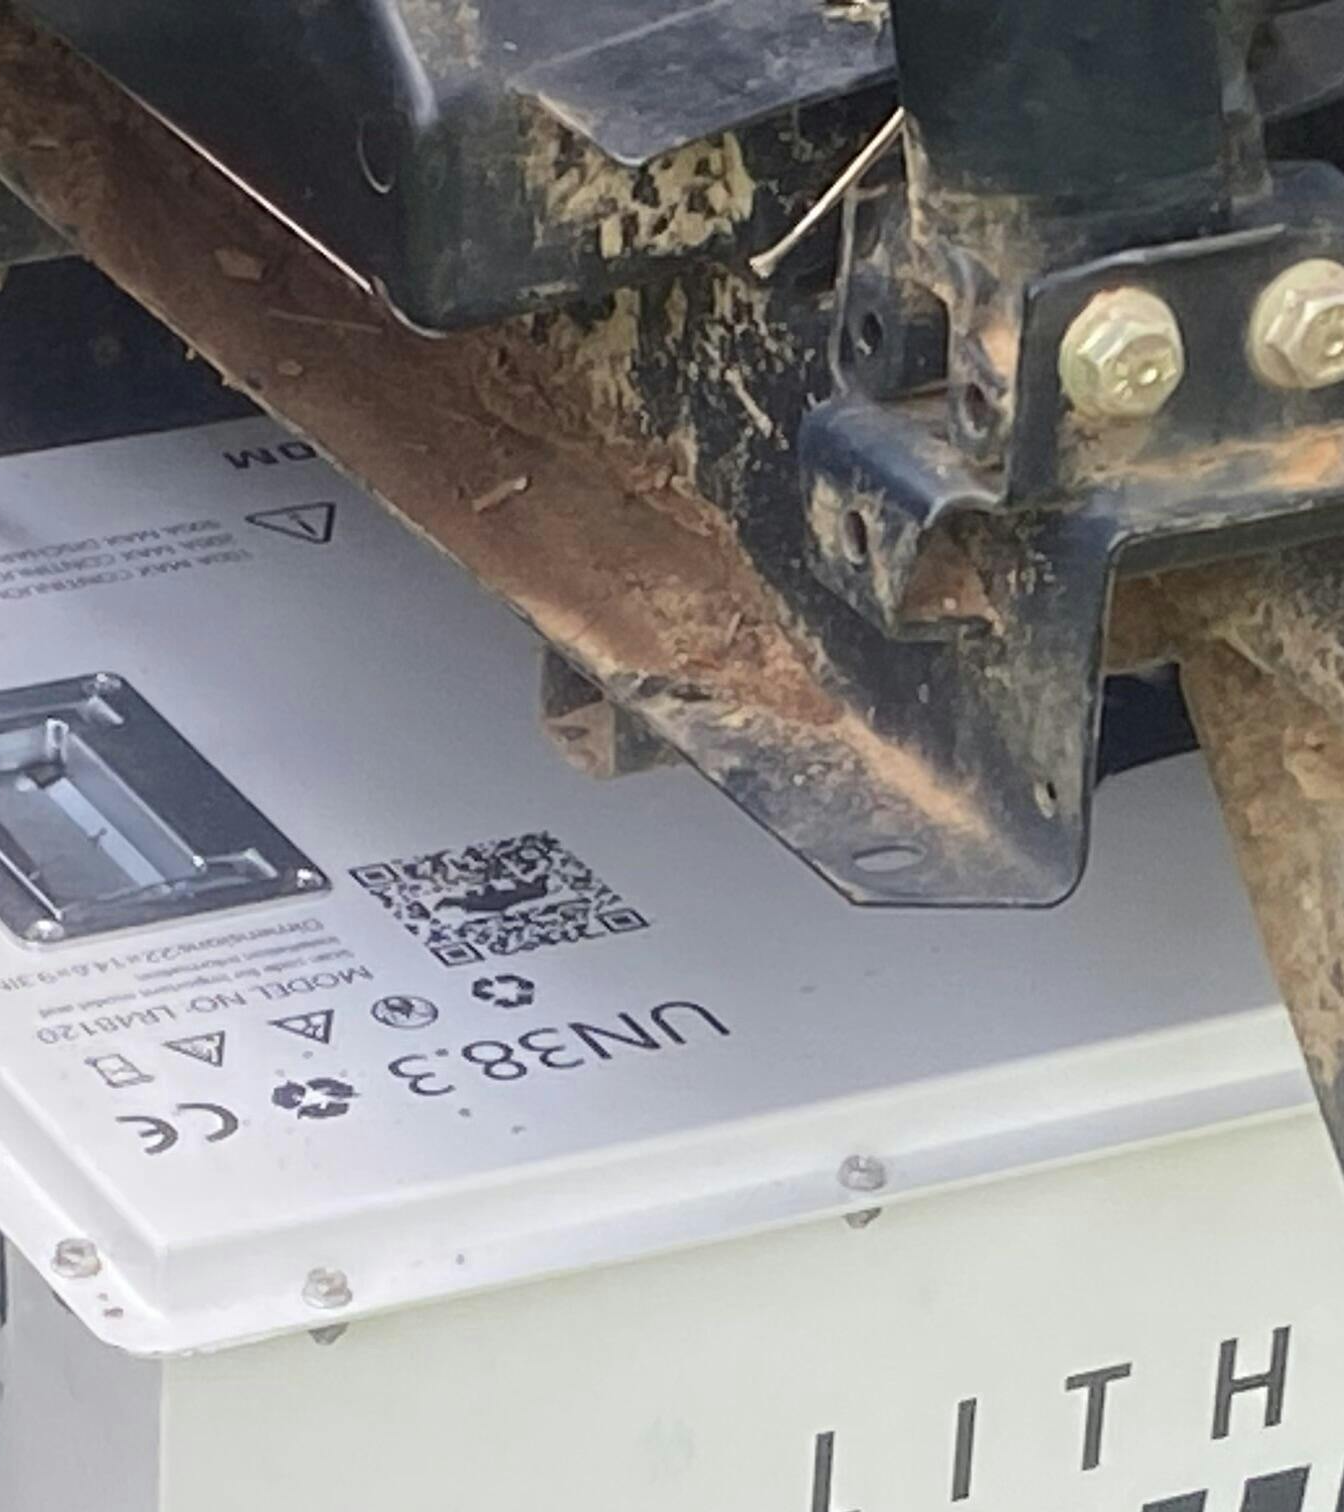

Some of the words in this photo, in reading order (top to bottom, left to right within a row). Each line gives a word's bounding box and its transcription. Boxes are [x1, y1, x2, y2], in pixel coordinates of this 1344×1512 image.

[248, 964, 374, 1000] MODEL
[36, 1003, 178, 1045] LR48120
[387, 1000, 730, 1097] UN38.3
